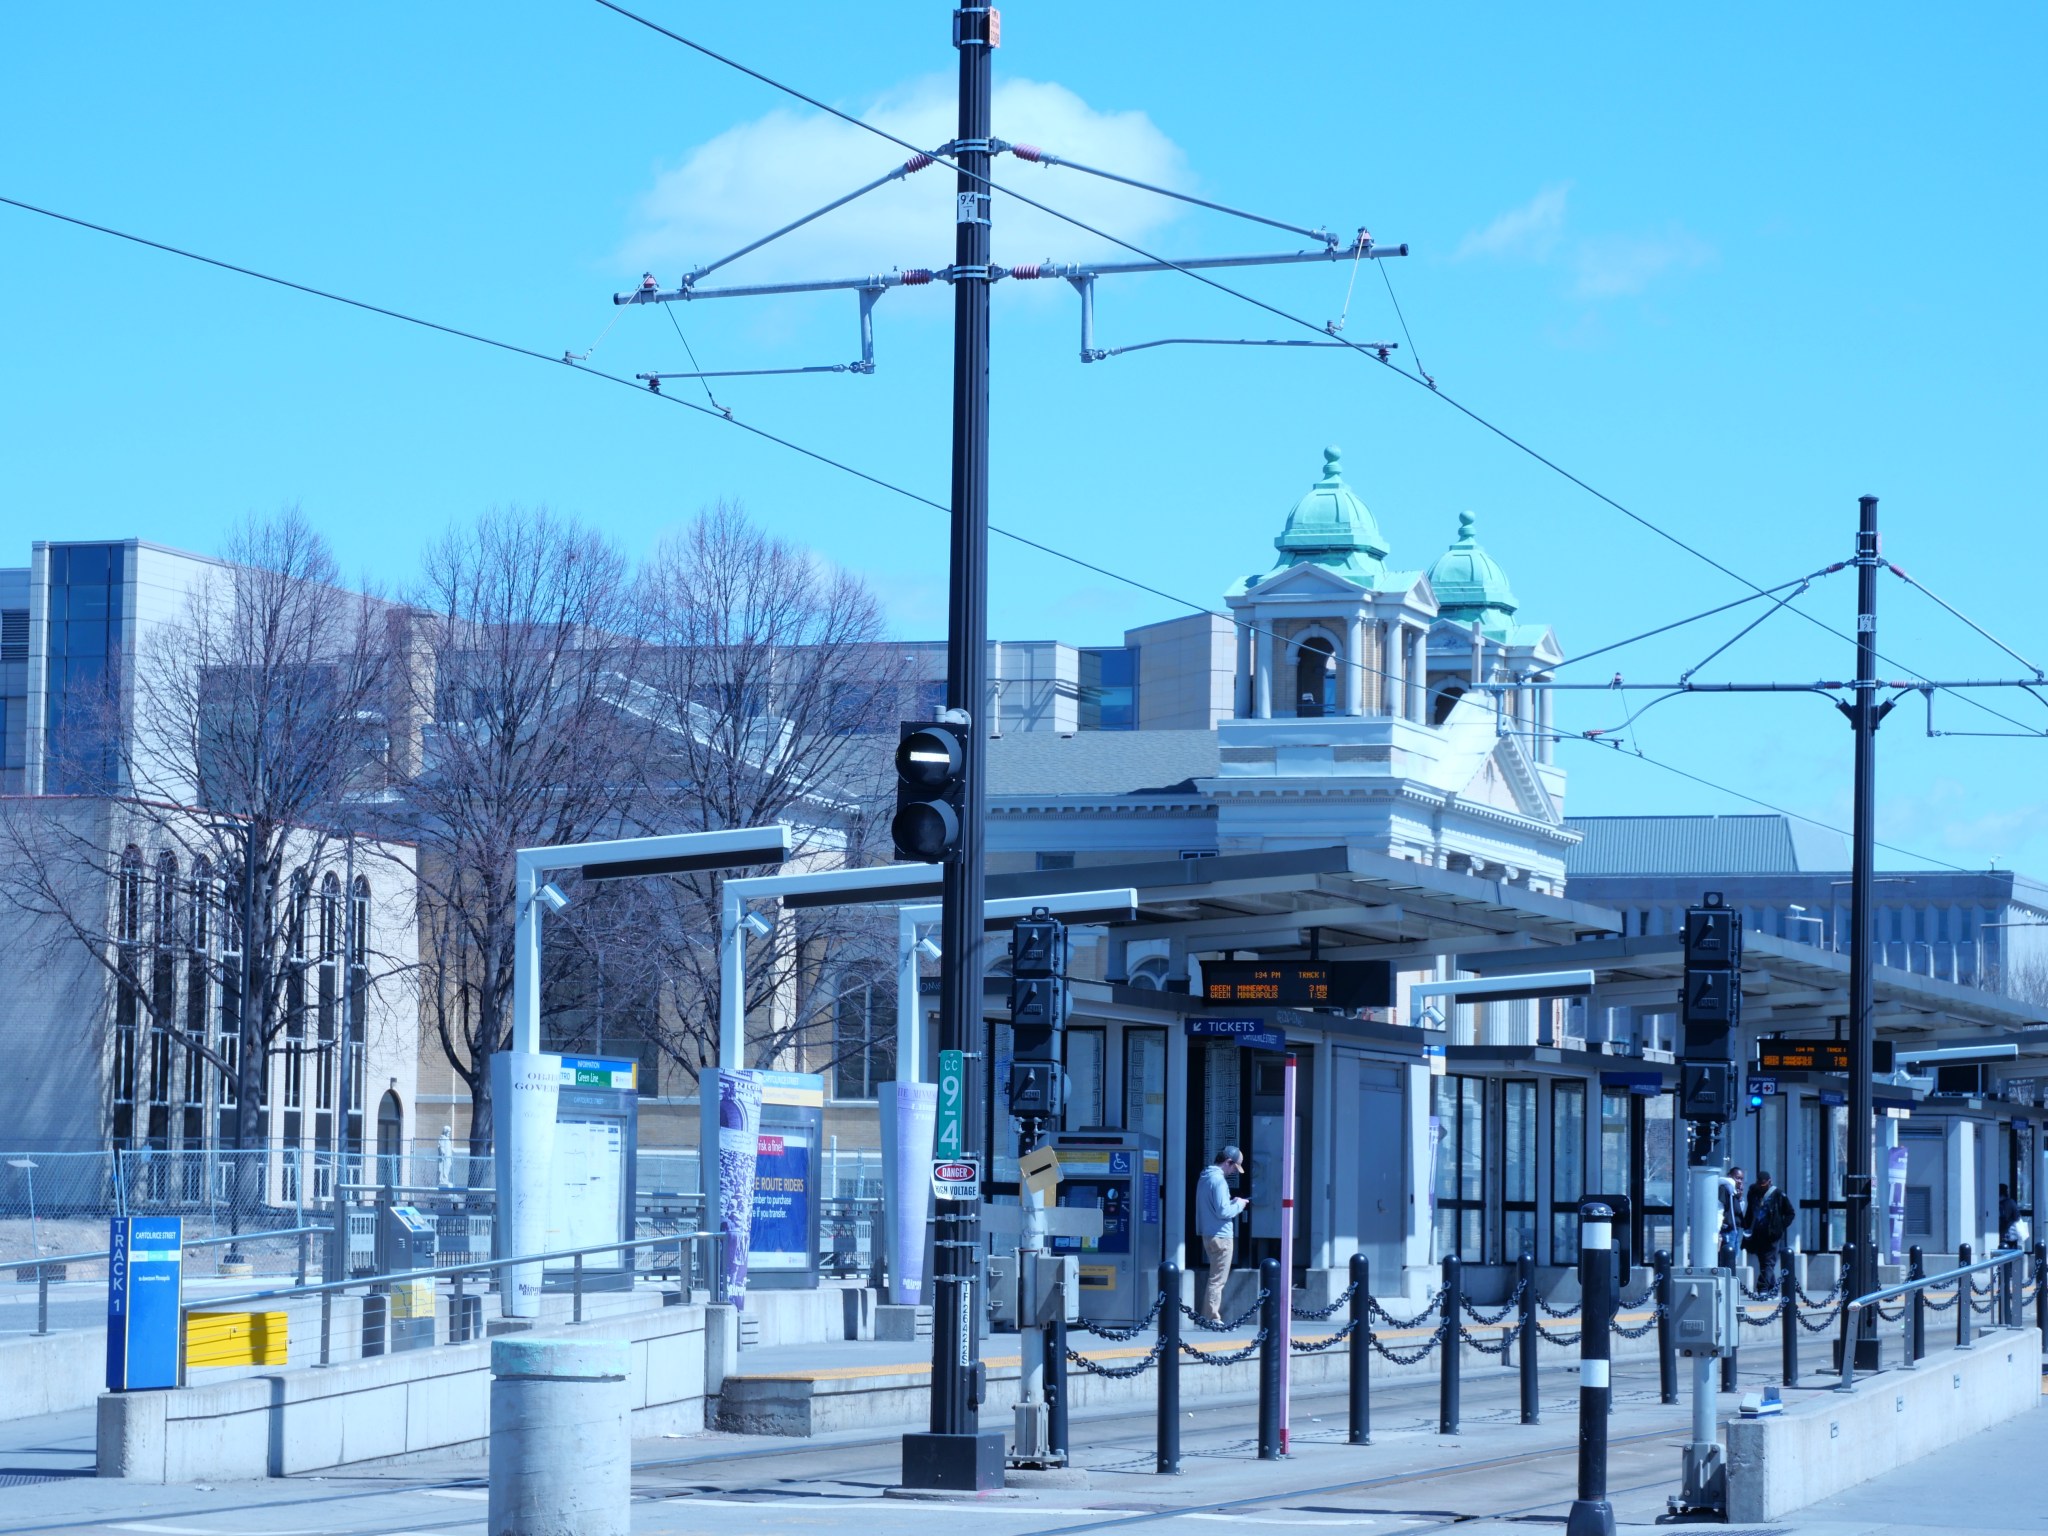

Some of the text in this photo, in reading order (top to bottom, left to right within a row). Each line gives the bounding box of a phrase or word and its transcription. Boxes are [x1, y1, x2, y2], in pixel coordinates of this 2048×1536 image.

[961, 195, 975, 204] 9.4
[1271, 971, 1281, 979] PM
[1298, 971, 1320, 979] TRACK
[1210, 984, 1231, 992] GREEN
[1237, 984, 1278, 992] MINNEAPOLIS
[1316, 984, 1328, 992] MIN
[1210, 991, 1231, 999] GREEN
[1237, 991, 1278, 999] MINNEAPOLIS
[1208, 1022, 1255, 1032] TICKETS
[577, 1060, 600, 1069] INFORMATION
[944, 1060, 958, 1071] CC
[577, 1071, 590, 1083] Green
[590, 1072, 599, 1083] Line
[758, 1140, 768, 1151] risk
[772, 1139, 783, 1152] fine!
[942, 1167, 968, 1178] DANGER
[761, 1177, 783, 1191] ROUTE
[784, 1178, 804, 1192] RIDERS
[949, 1186, 977, 1196] VOLTAGE
[767, 1194, 773, 1205] to
[772, 1194, 792, 1207] purchase
[756, 1206, 761, 1218] if
[760, 1209, 769, 1220] you
[113, 1220, 125, 1312] TRACK 1
